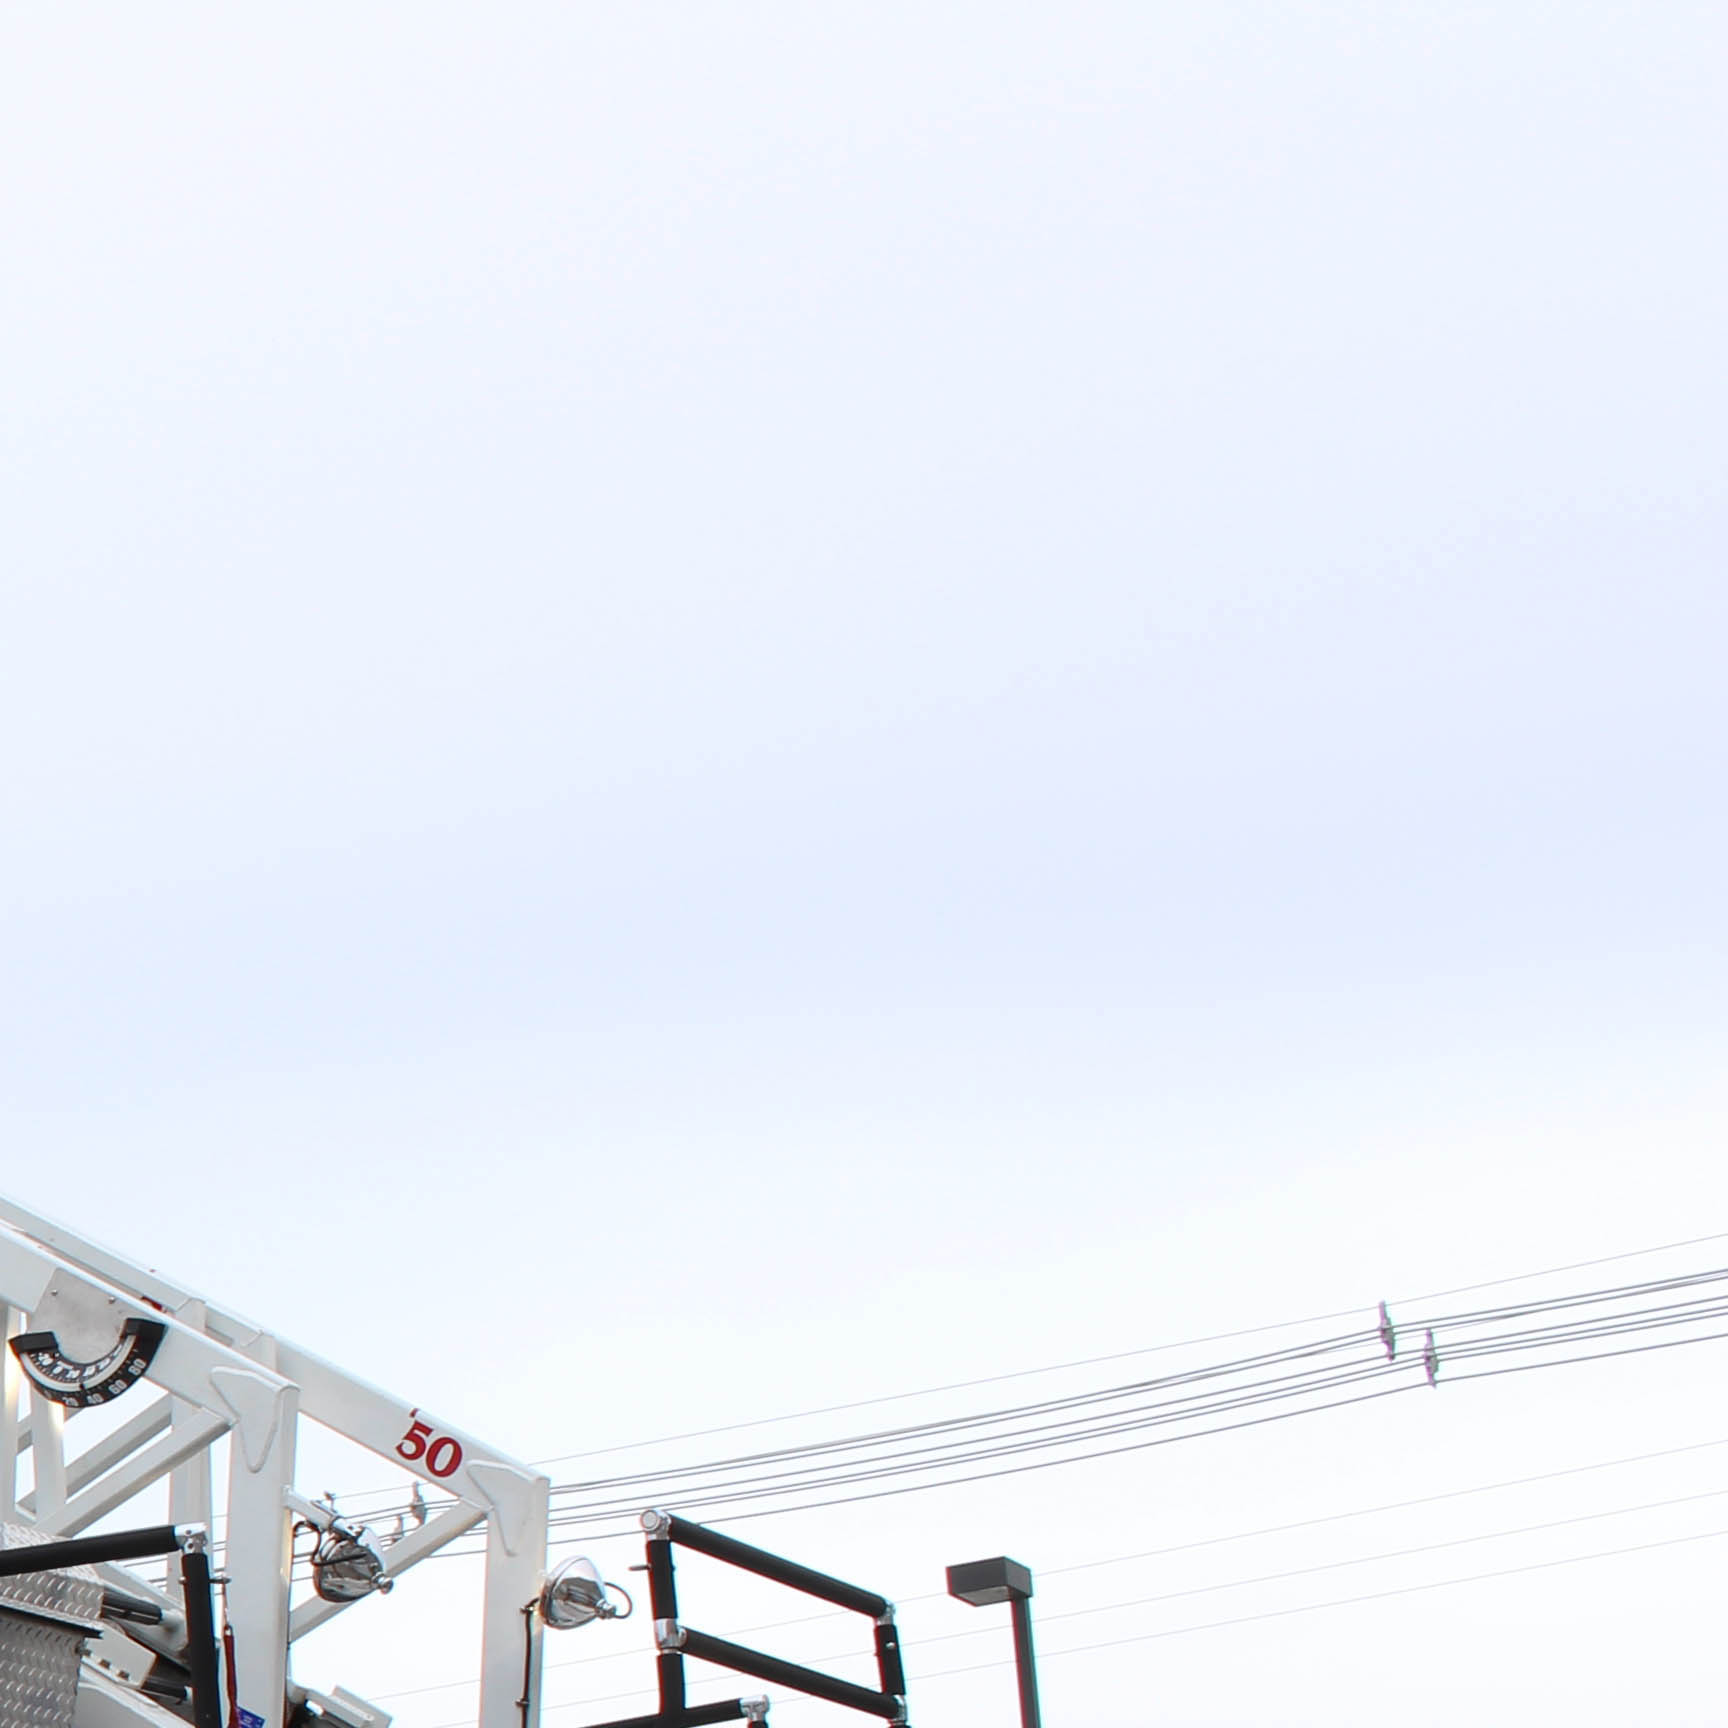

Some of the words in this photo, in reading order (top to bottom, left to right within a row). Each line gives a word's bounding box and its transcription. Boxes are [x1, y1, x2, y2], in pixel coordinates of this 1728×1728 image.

[108, 1379, 128, 1394] 60
[128, 1358, 146, 1375] 80
[396, 1420, 463, 1478] 50
